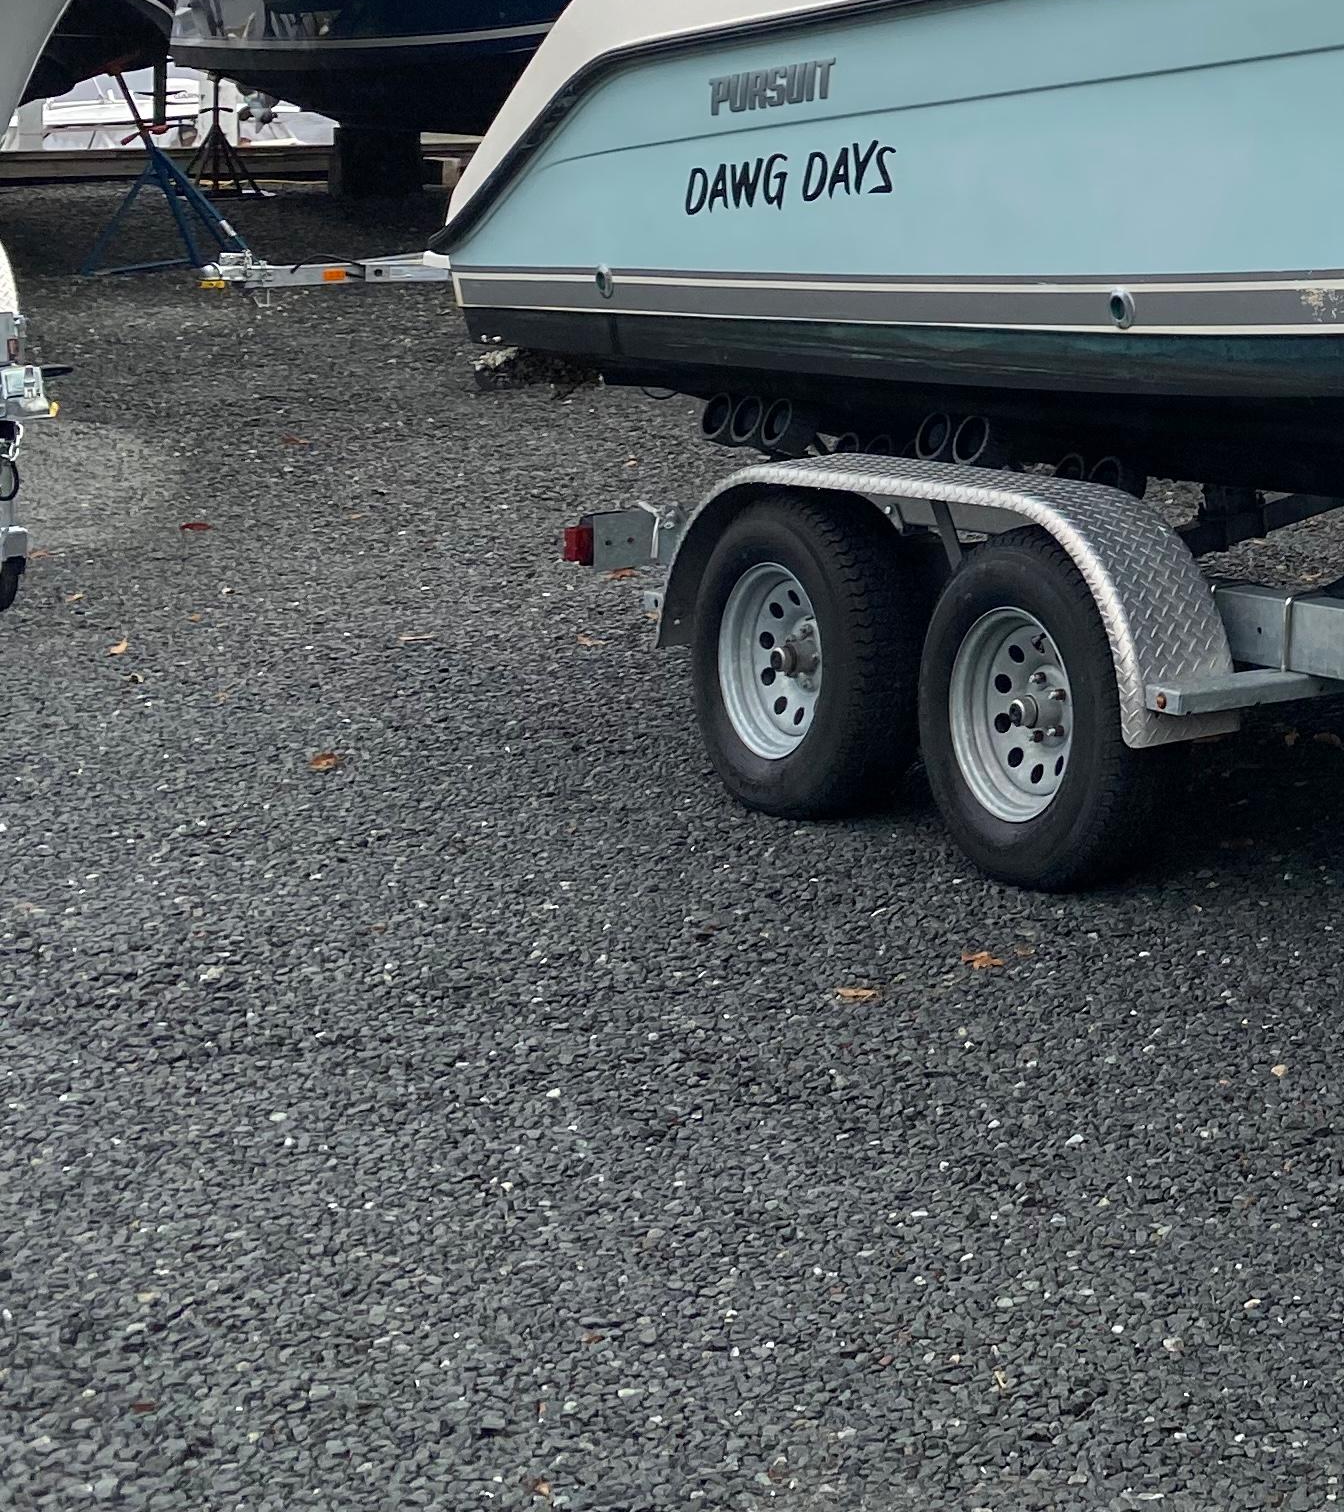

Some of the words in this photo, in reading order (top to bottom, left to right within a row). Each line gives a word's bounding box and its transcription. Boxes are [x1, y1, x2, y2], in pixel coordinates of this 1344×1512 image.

[708, 57, 836, 117] PURSUIT
[685, 153, 788, 216] DAWG
[802, 139, 896, 202] DAYS
